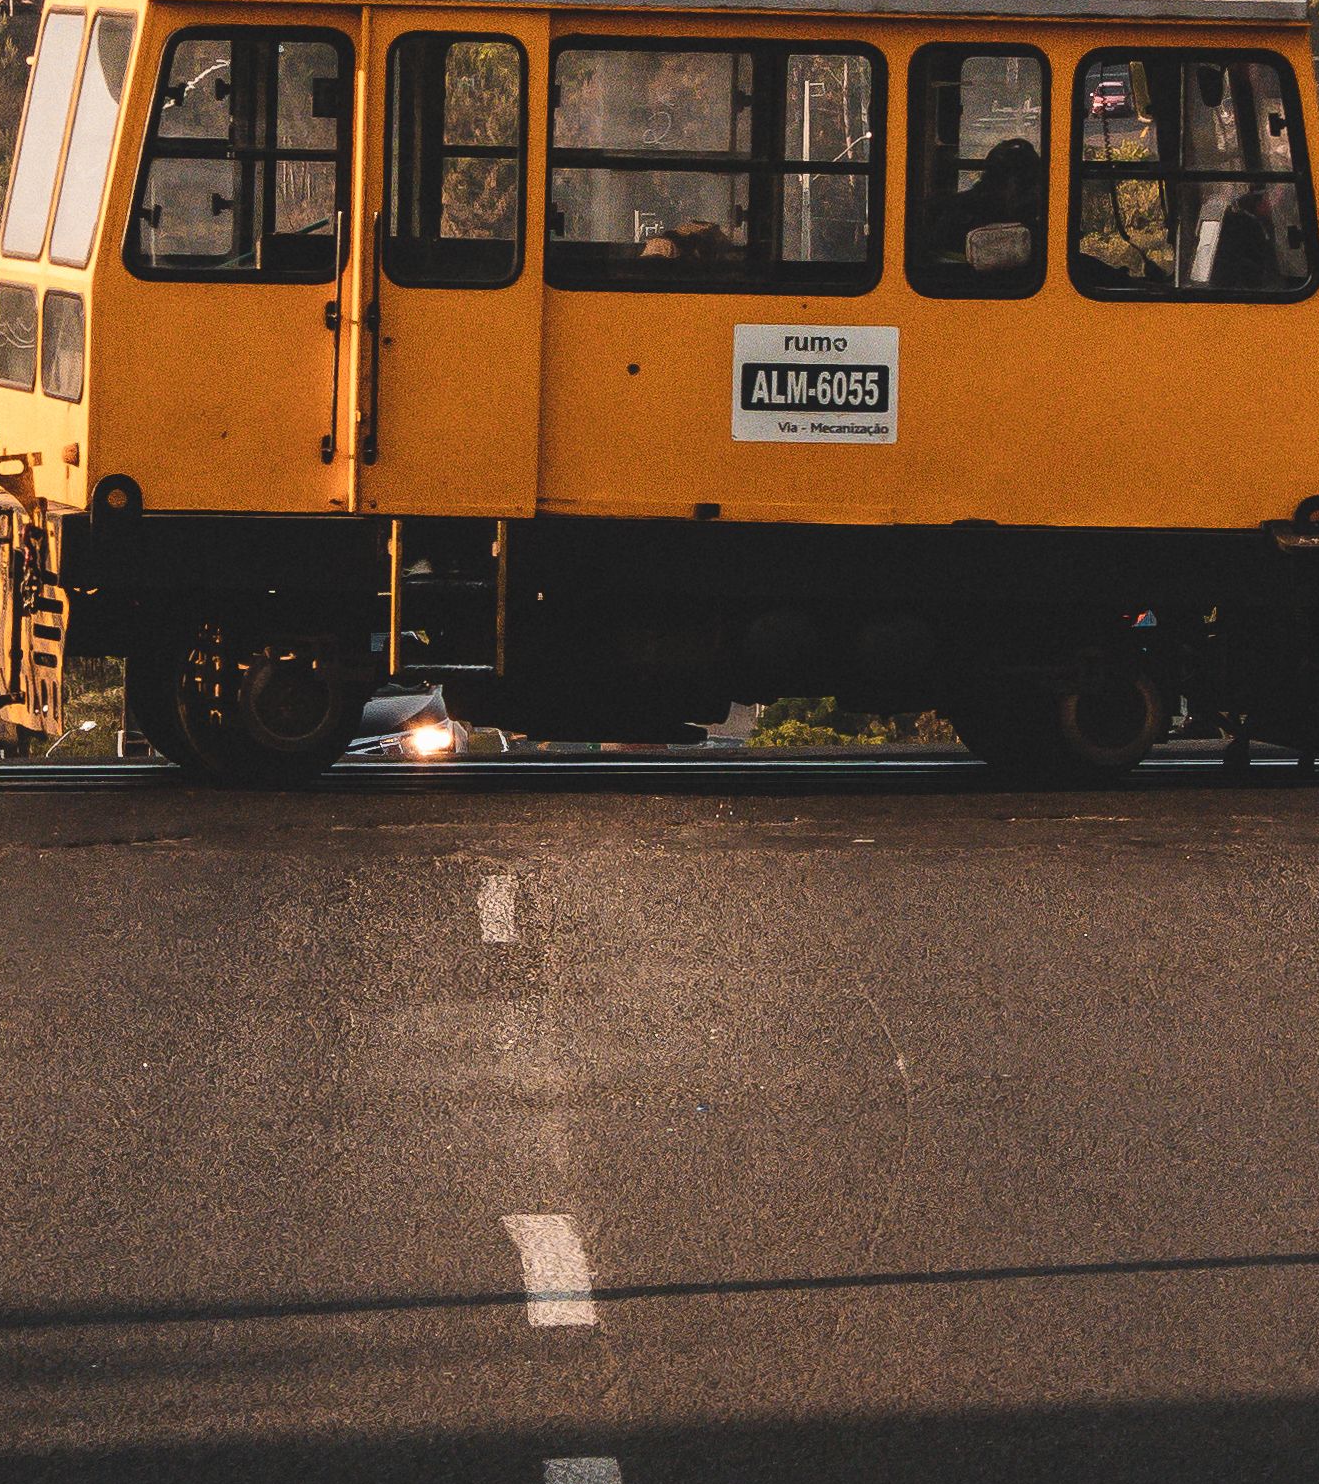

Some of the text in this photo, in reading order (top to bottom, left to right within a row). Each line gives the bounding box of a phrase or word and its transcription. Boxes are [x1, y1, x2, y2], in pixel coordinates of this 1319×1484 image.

[784, 335, 848, 352] rumo
[750, 370, 879, 406] ALM-6055
[777, 421, 798, 433] Via
[810, 422, 889, 436] Mecanização
